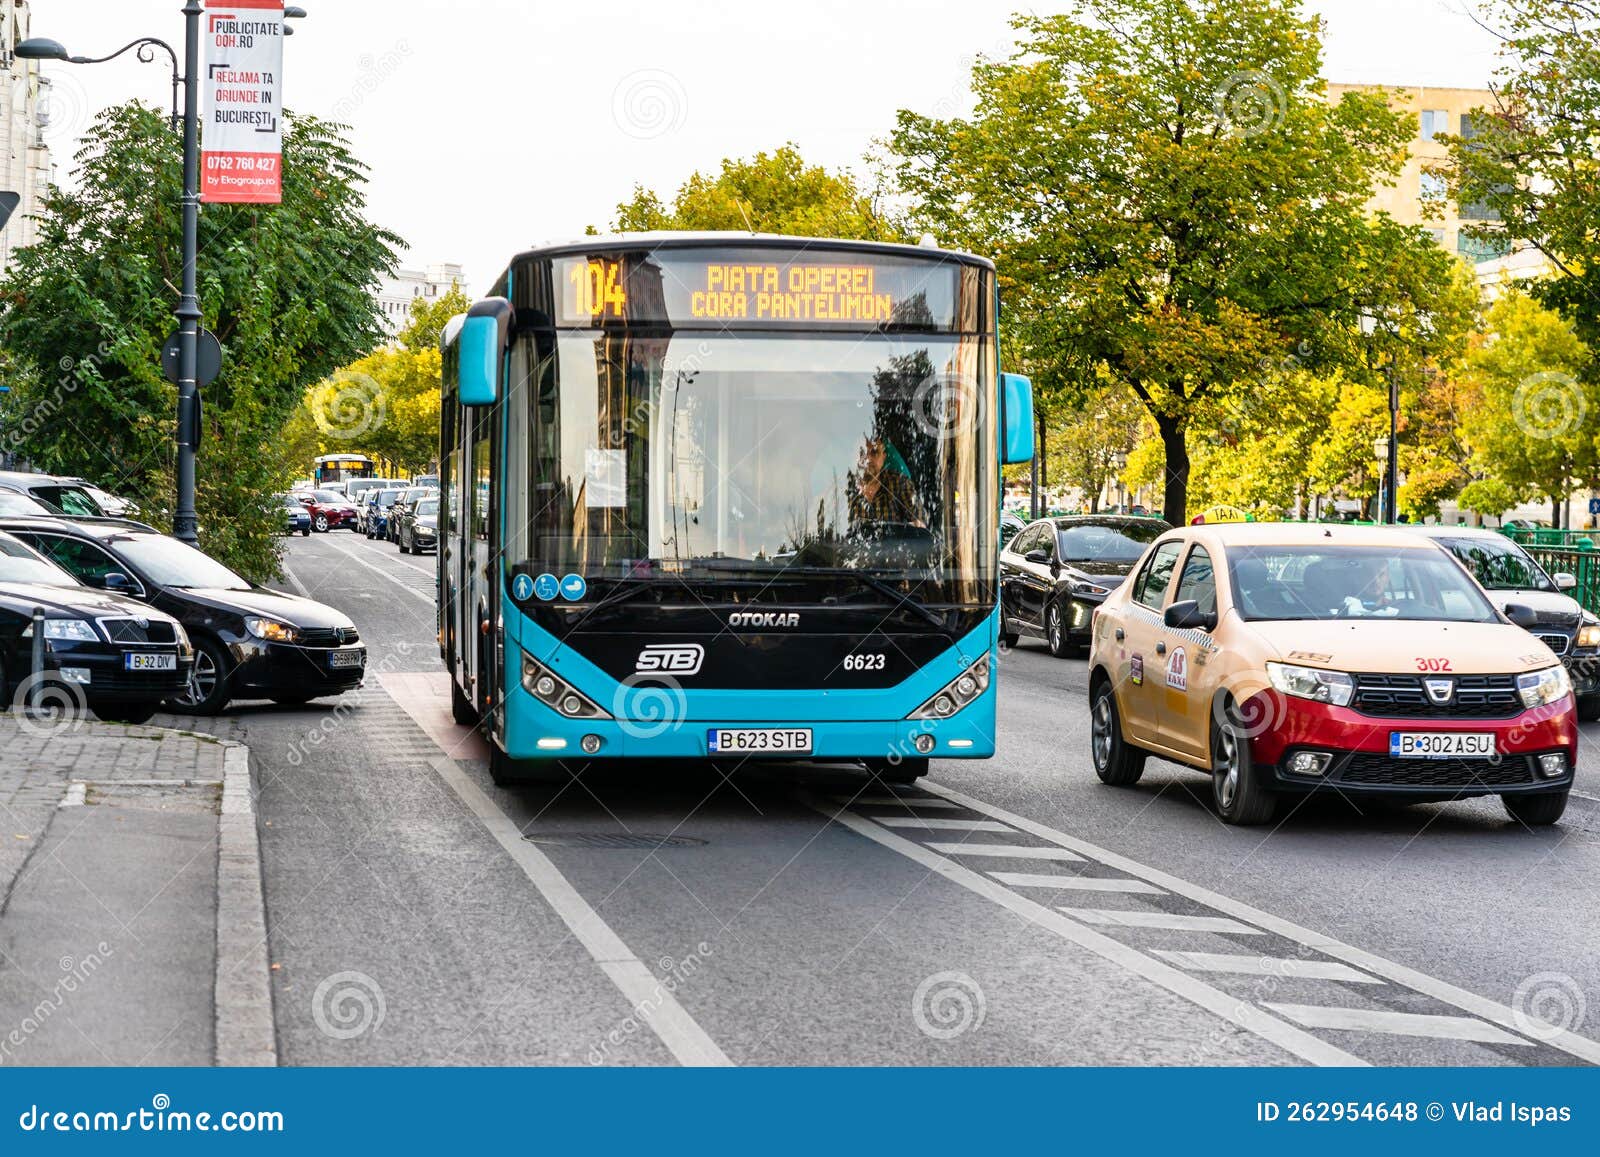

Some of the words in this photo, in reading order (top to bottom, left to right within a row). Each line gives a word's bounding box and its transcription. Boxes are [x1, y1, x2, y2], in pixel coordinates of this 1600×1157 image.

[216, 21, 279, 36] PUBLICITATE
[215, 34, 253, 48] OOH.RO
[216, 71, 260, 84] RECLAMA
[262, 73, 273, 84] TA
[215, 89, 258, 103] ORIUNDE
[261, 91, 272, 104] IN
[207, 156, 232, 169] 0752
[235, 157, 254, 170] 760
[256, 158, 276, 171] 427
[207, 175, 218, 186] by
[221, 175, 275, 186] Ekogroup.ro
[707, 265, 779, 292] PIATA
[789, 267, 873, 293] OPEREI
[569, 262, 626, 316] 104
[691, 291, 747, 318] CORA
[757, 292, 891, 319] PANTELIMON
[1213, 508, 1239, 520] TAXI
[729, 612, 800, 627] OTOKAR
[144, 656, 155, 668] 32
[636, 648, 700, 672] STB
[843, 654, 886, 670] 6623
[1171, 652, 1185, 675] AS
[1416, 657, 1453, 672] 302
[1168, 673, 1186, 687] TAXI
[720, 732, 733, 749] B
[737, 732, 768, 749] 623
[772, 732, 807, 748] STB
[1402, 736, 1415, 752] B
[1422, 736, 1453, 752] 302
[1456, 736, 1490, 752] ASU
